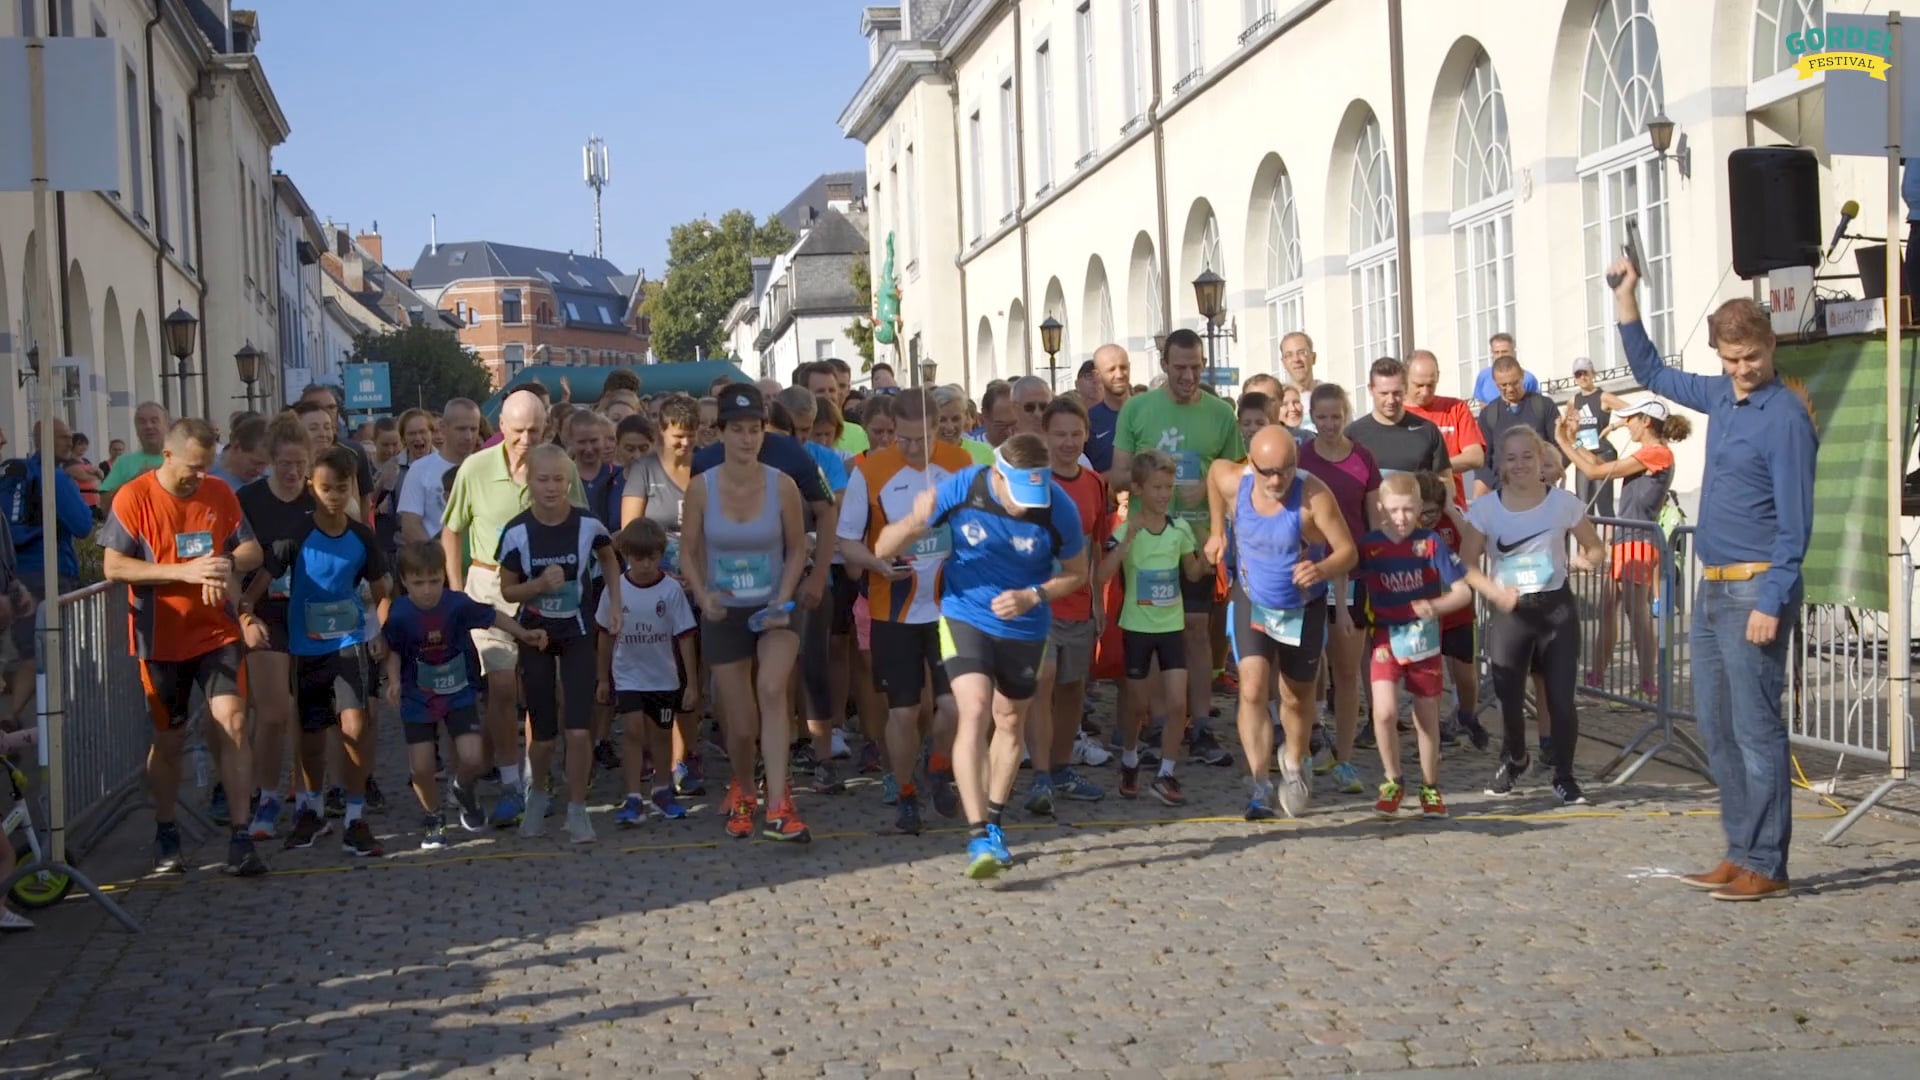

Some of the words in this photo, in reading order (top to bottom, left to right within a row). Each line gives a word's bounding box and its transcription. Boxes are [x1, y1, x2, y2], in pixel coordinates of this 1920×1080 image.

[1769, 289, 1781, 313] ON
[1783, 287, 1796, 312] AIR
[352, 394, 383, 403] BAGAGE
[916, 537, 938, 553] 317
[1380, 568, 1423, 590] QATAR
[1515, 569, 1538, 585] 105
[541, 598, 562, 611] 127
[327, 617, 337, 631] 2
[634, 622, 652, 634] Fly
[434, 675, 455, 689] 128
[660, 708, 673, 722] 10
